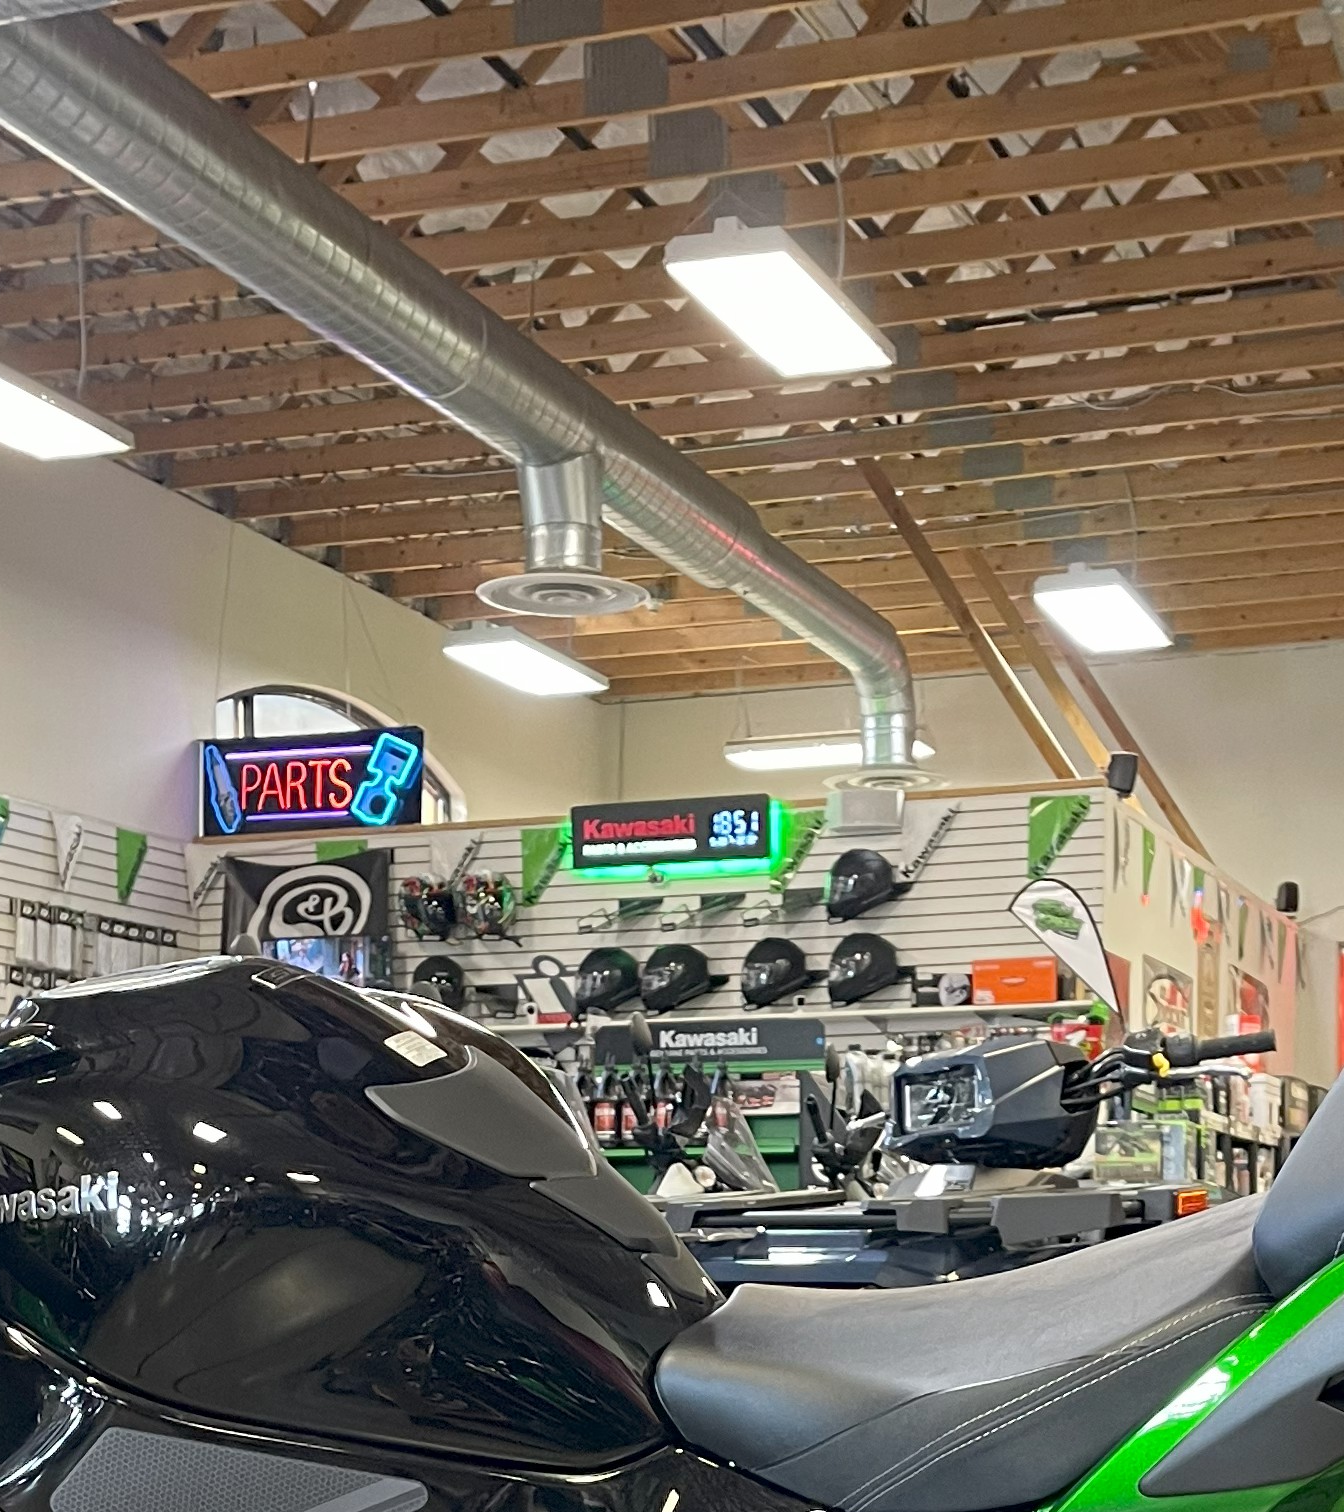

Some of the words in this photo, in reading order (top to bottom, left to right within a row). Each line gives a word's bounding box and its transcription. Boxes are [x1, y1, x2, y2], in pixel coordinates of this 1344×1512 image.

[240, 756, 356, 813] PARTS
[582, 812, 696, 841] Kawasaki
[659, 1027, 759, 1049] Kawasaki
